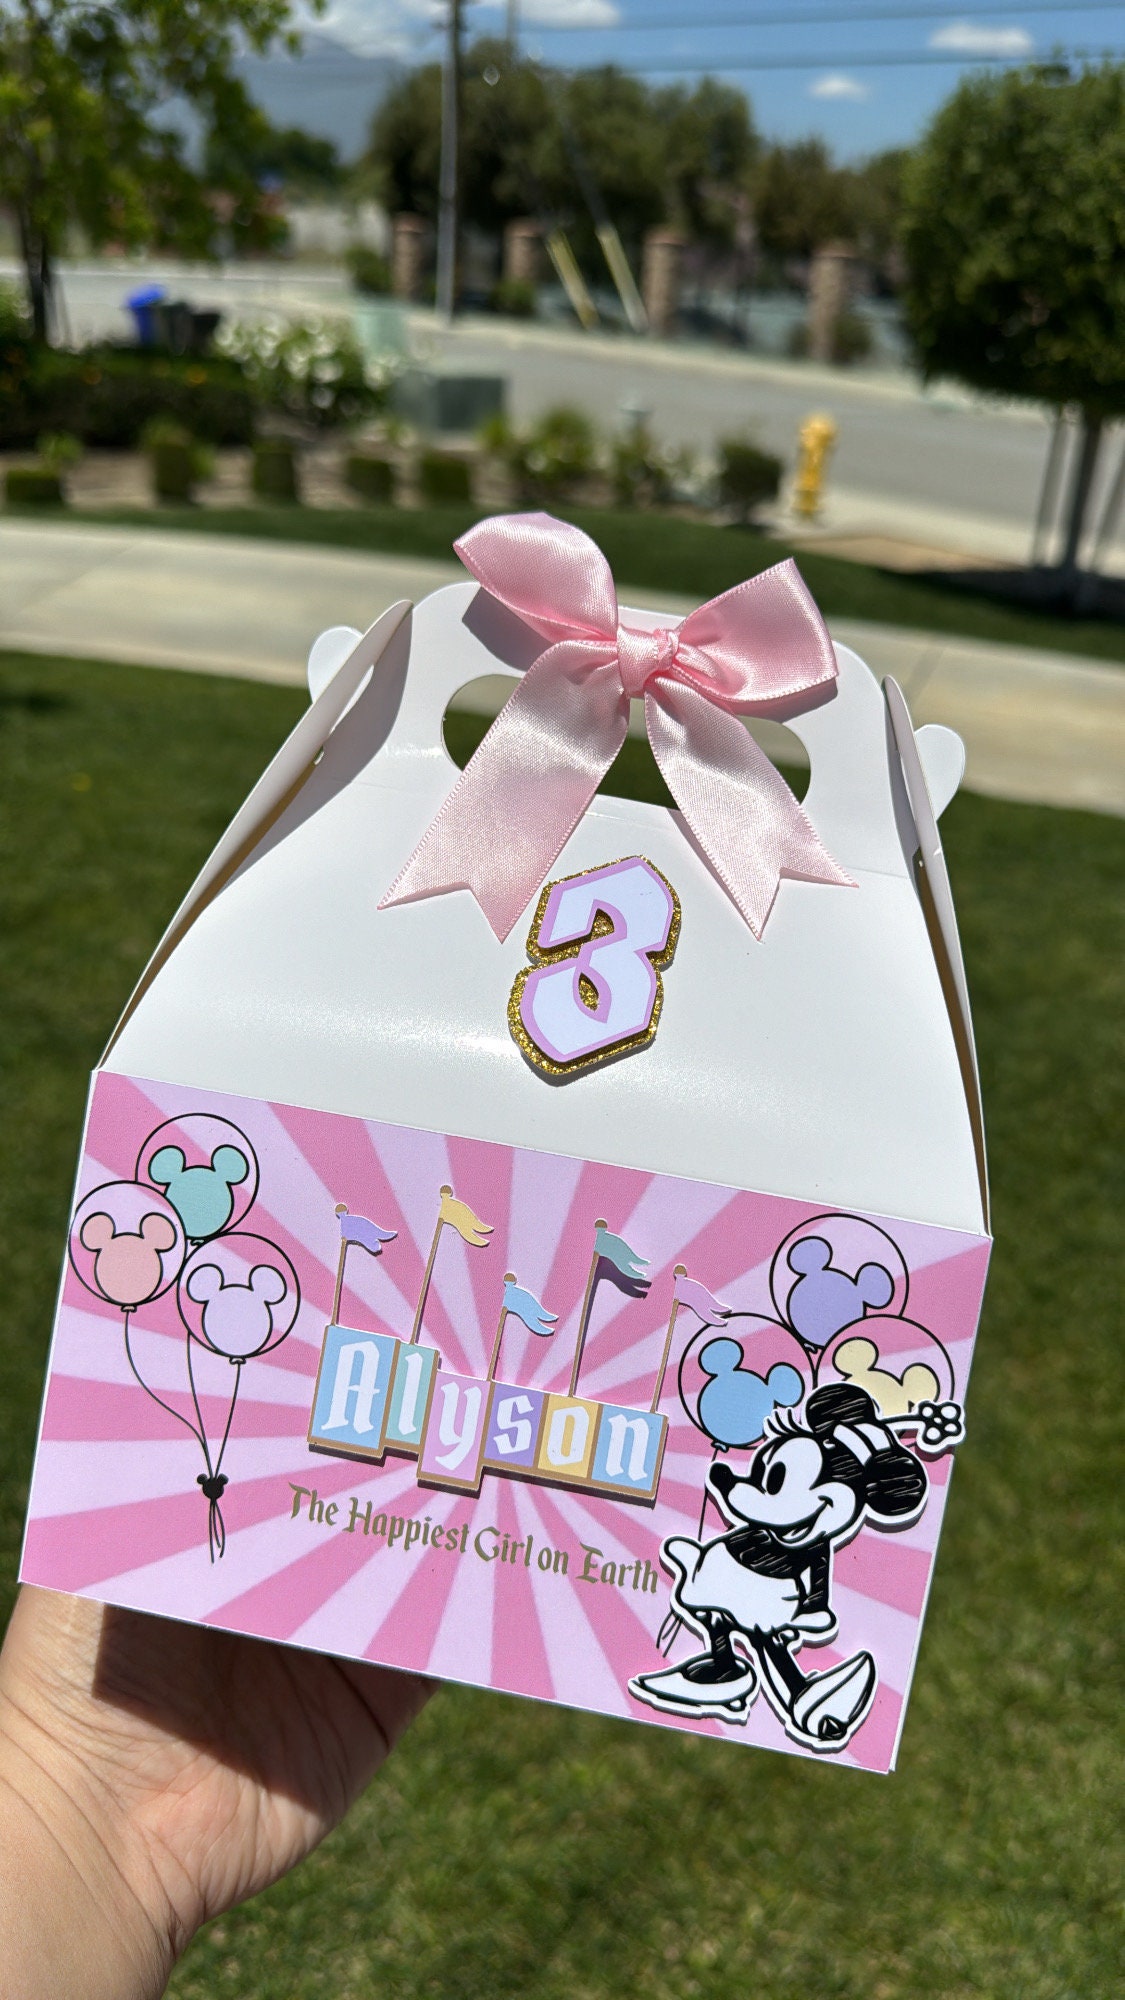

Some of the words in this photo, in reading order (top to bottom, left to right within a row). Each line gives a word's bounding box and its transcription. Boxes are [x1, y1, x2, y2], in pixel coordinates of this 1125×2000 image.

[518, 855, 676, 1065] 3
[321, 1340, 652, 1482] Alyson
[288, 1482, 339, 1527] The
[343, 1496, 470, 1553] Happiest
[474, 1526, 533, 1567] Girl
[537, 1546, 569, 1576] on
[575, 1541, 659, 1594] Earth
